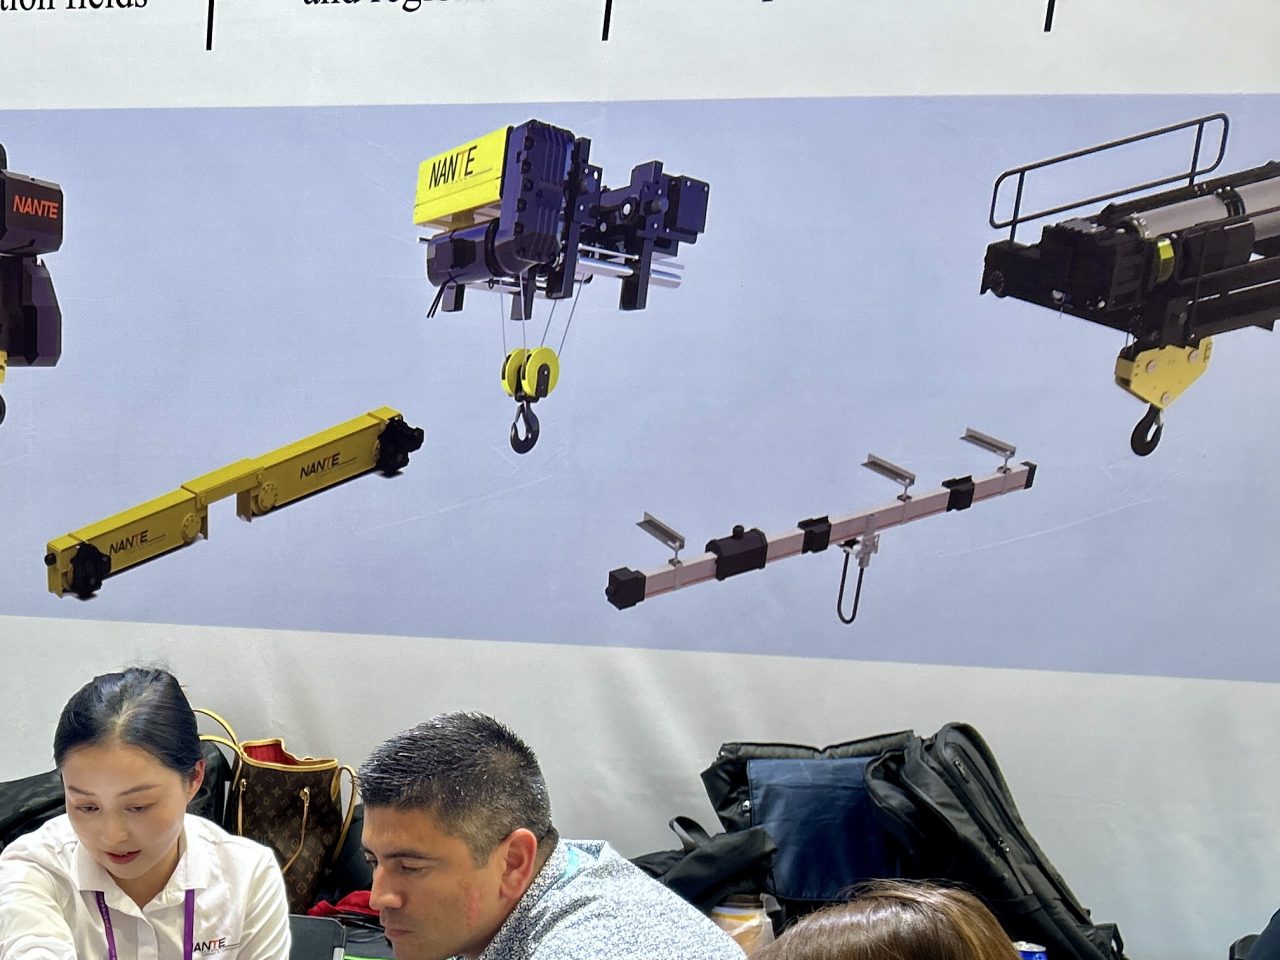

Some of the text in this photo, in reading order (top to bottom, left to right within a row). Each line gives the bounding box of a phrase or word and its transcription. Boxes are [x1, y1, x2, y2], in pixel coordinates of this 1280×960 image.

[428, 145, 478, 190] NANTE
[13, 195, 59, 219] NANTE
[299, 452, 341, 480] NANTE
[109, 529, 149, 557] NANTE
[192, 937, 226, 952] ANTE
